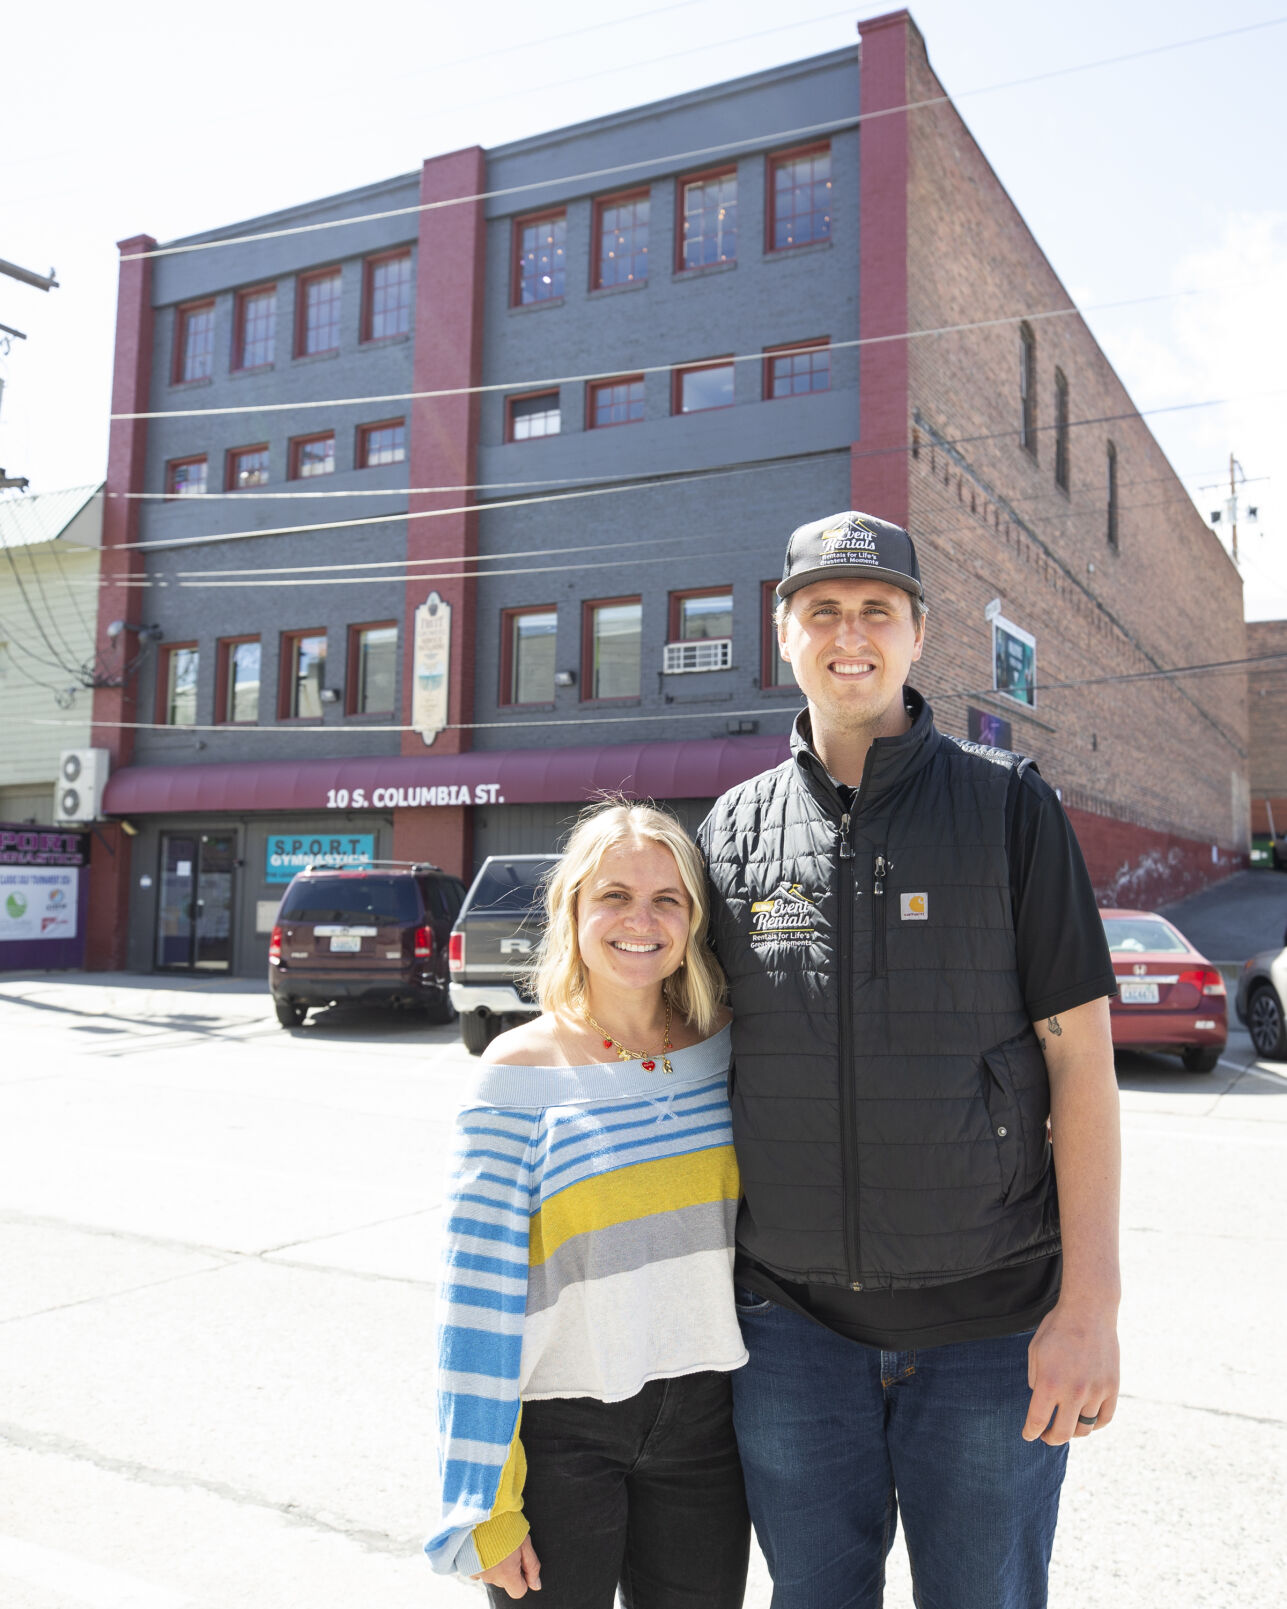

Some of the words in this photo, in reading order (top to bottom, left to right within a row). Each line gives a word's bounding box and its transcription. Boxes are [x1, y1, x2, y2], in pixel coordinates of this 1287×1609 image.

[837, 528, 873, 541] Event
[823, 538, 876, 553] Rentals
[327, 789, 349, 808] 10
[352, 789, 369, 808] S.
[373, 786, 471, 807] COLUMBIA
[475, 784, 505, 804] ST.
[270, 854, 369, 867] GYMNASTICS
[770, 899, 809, 917] Event
[752, 911, 810, 931] Rentals
[752, 933, 777, 942] Rentals
[777, 932, 789, 941] for
[790, 931, 810, 939] Life's
